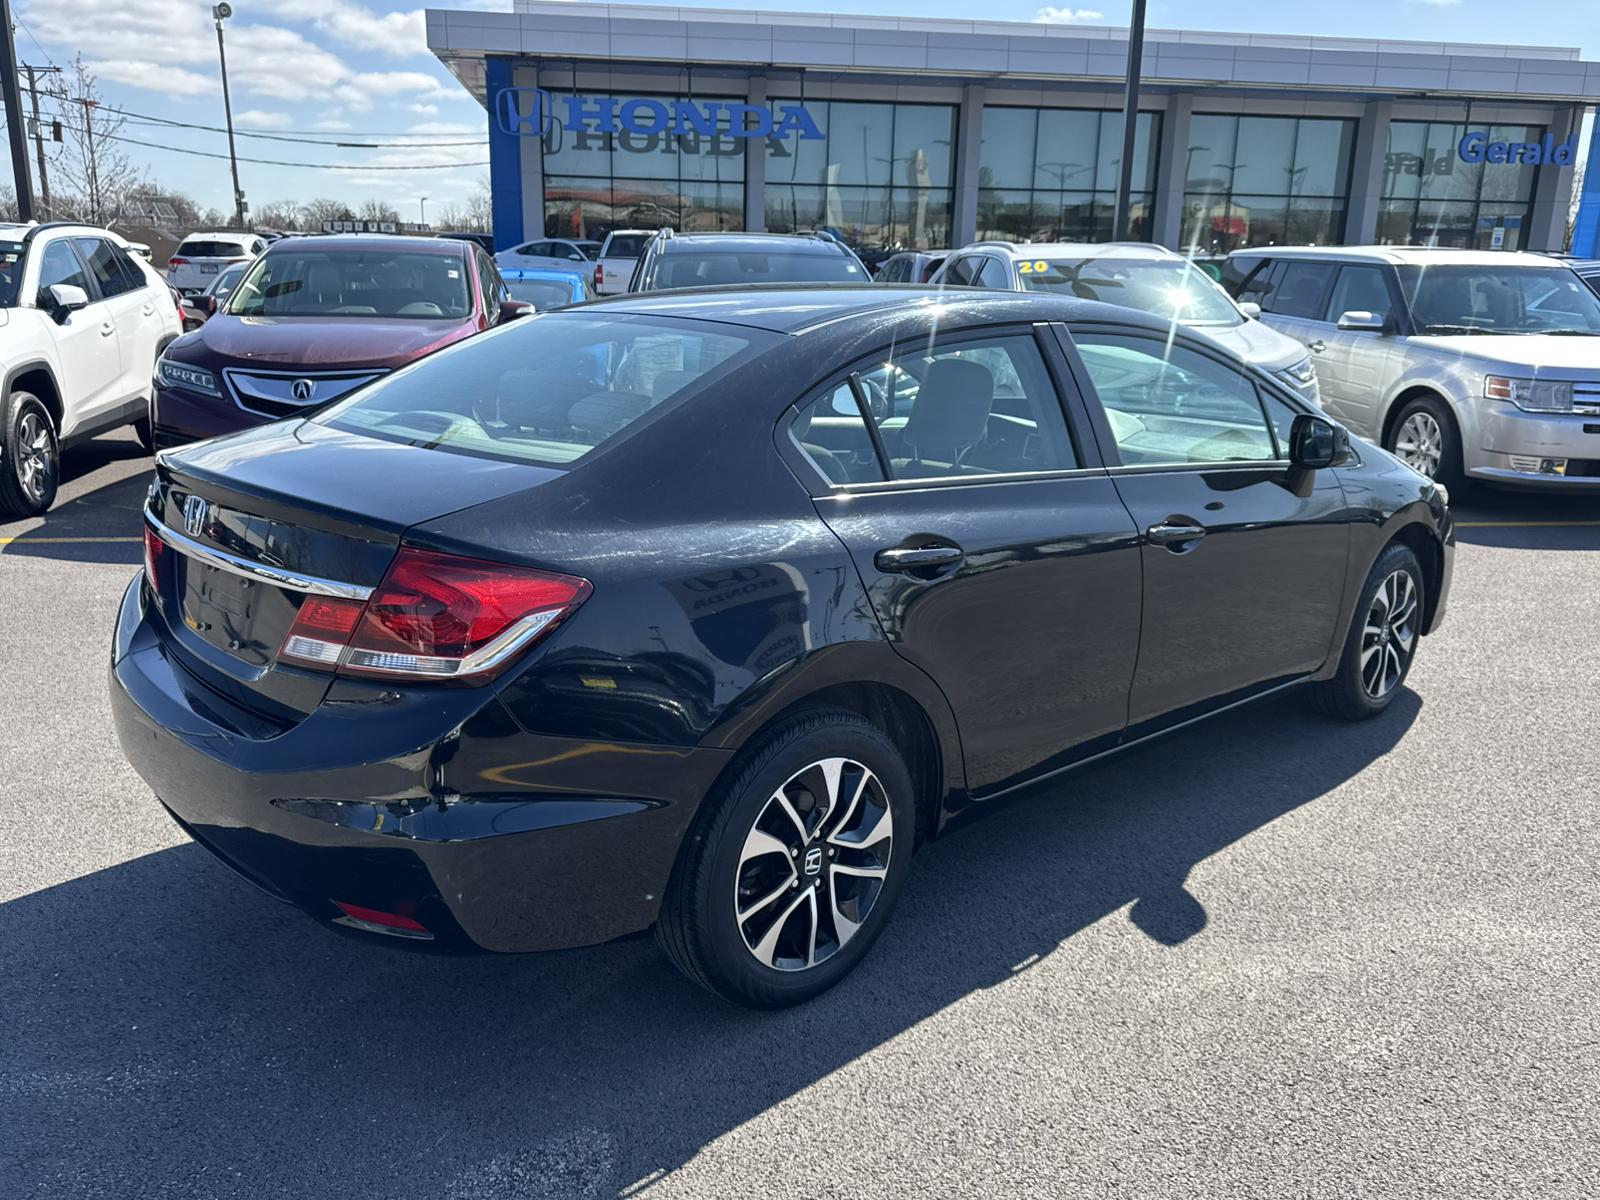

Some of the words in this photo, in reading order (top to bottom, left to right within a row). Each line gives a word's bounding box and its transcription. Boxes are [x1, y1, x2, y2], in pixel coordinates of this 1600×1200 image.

[563, 97, 826, 140] HONDA
[1384, 148, 1456, 176] erald
[1458, 131, 1579, 166] Gerald
[1018, 260, 1049, 274] 20
